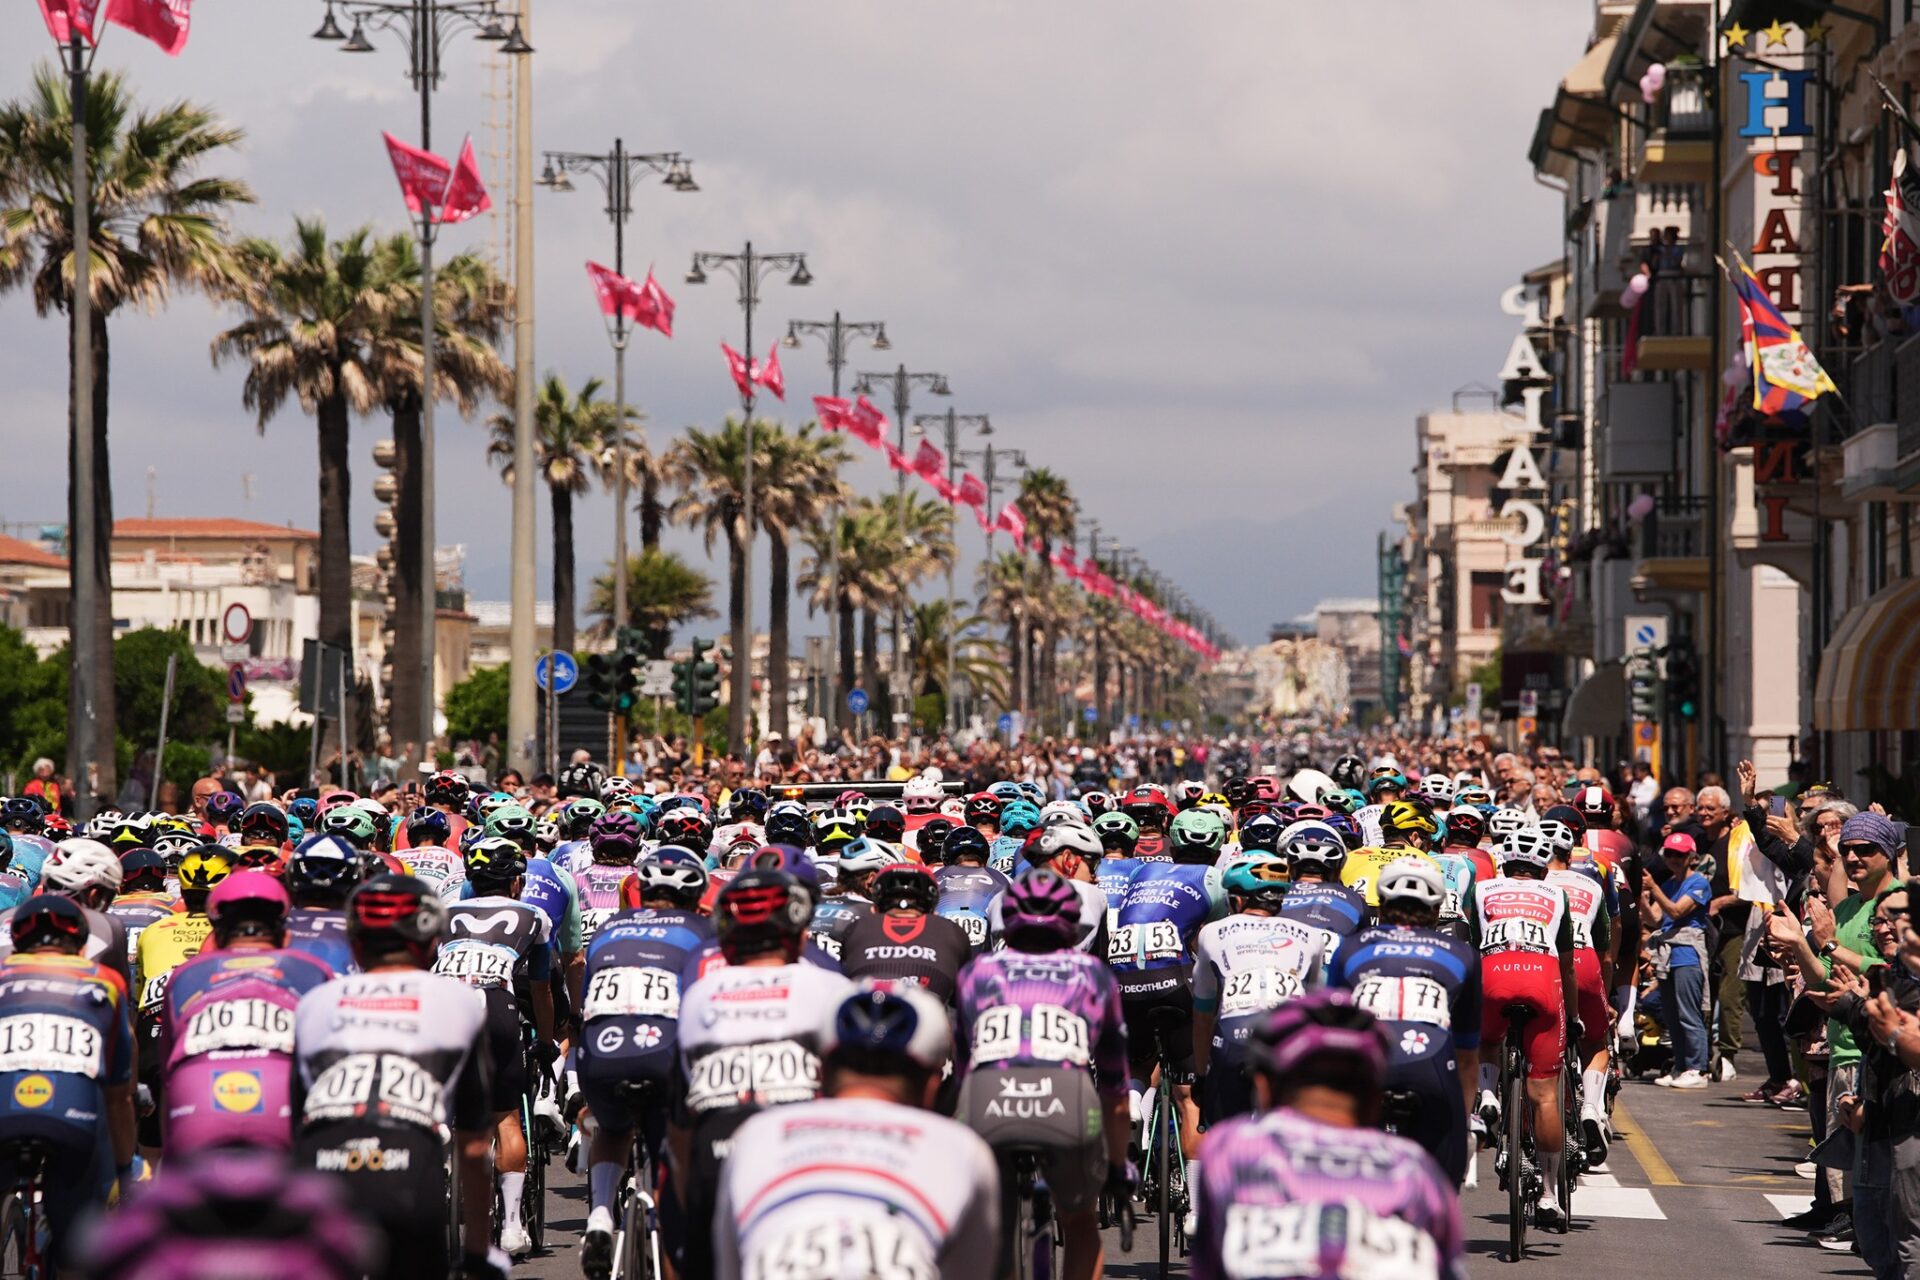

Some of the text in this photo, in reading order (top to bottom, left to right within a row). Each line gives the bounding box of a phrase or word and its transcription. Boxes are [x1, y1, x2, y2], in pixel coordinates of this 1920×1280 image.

[1739, 70, 1814, 137] H
[1133, 879, 1202, 901] DECATHLON
[1161, 889, 1175, 899] LA
[1487, 892, 1550, 906] POLTI
[1537, 884, 1557, 896] solo
[1127, 896, 1181, 909] MONDIALE
[1485, 904, 1549, 920] VisitMalta
[604, 914, 687, 931] Groupama
[610, 927, 645, 939] FDJ
[1218, 922, 1310, 940] BAHRAIN
[1520, 920, 1548, 945] 171
[1110, 928, 1133, 955] 53
[1152, 925, 1177, 949] 53
[1359, 929, 1452, 950] Groupama
[1483, 922, 1508, 947] 171
[864, 945, 937, 962] TUDOR
[1152, 951, 1178, 960] TUDOR
[1373, 943, 1414, 957] FDJ
[1493, 963, 1544, 972] AURUM
[592, 972, 621, 1002] 75
[641, 972, 670, 1001] 75
[1124, 977, 1178, 993] DECATHLON
[1226, 972, 1253, 998] 32
[1274, 971, 1298, 998] 32
[1415, 982, 1442, 1009] 77
[246, 999, 289, 1034] 116
[3, 1022, 34, 1055] 13
[51, 1022, 94, 1058] 113
[1038, 1010, 1084, 1049] 151
[757, 1049, 818, 1084] 206
[984, 1098, 1066, 1119] ALULA
